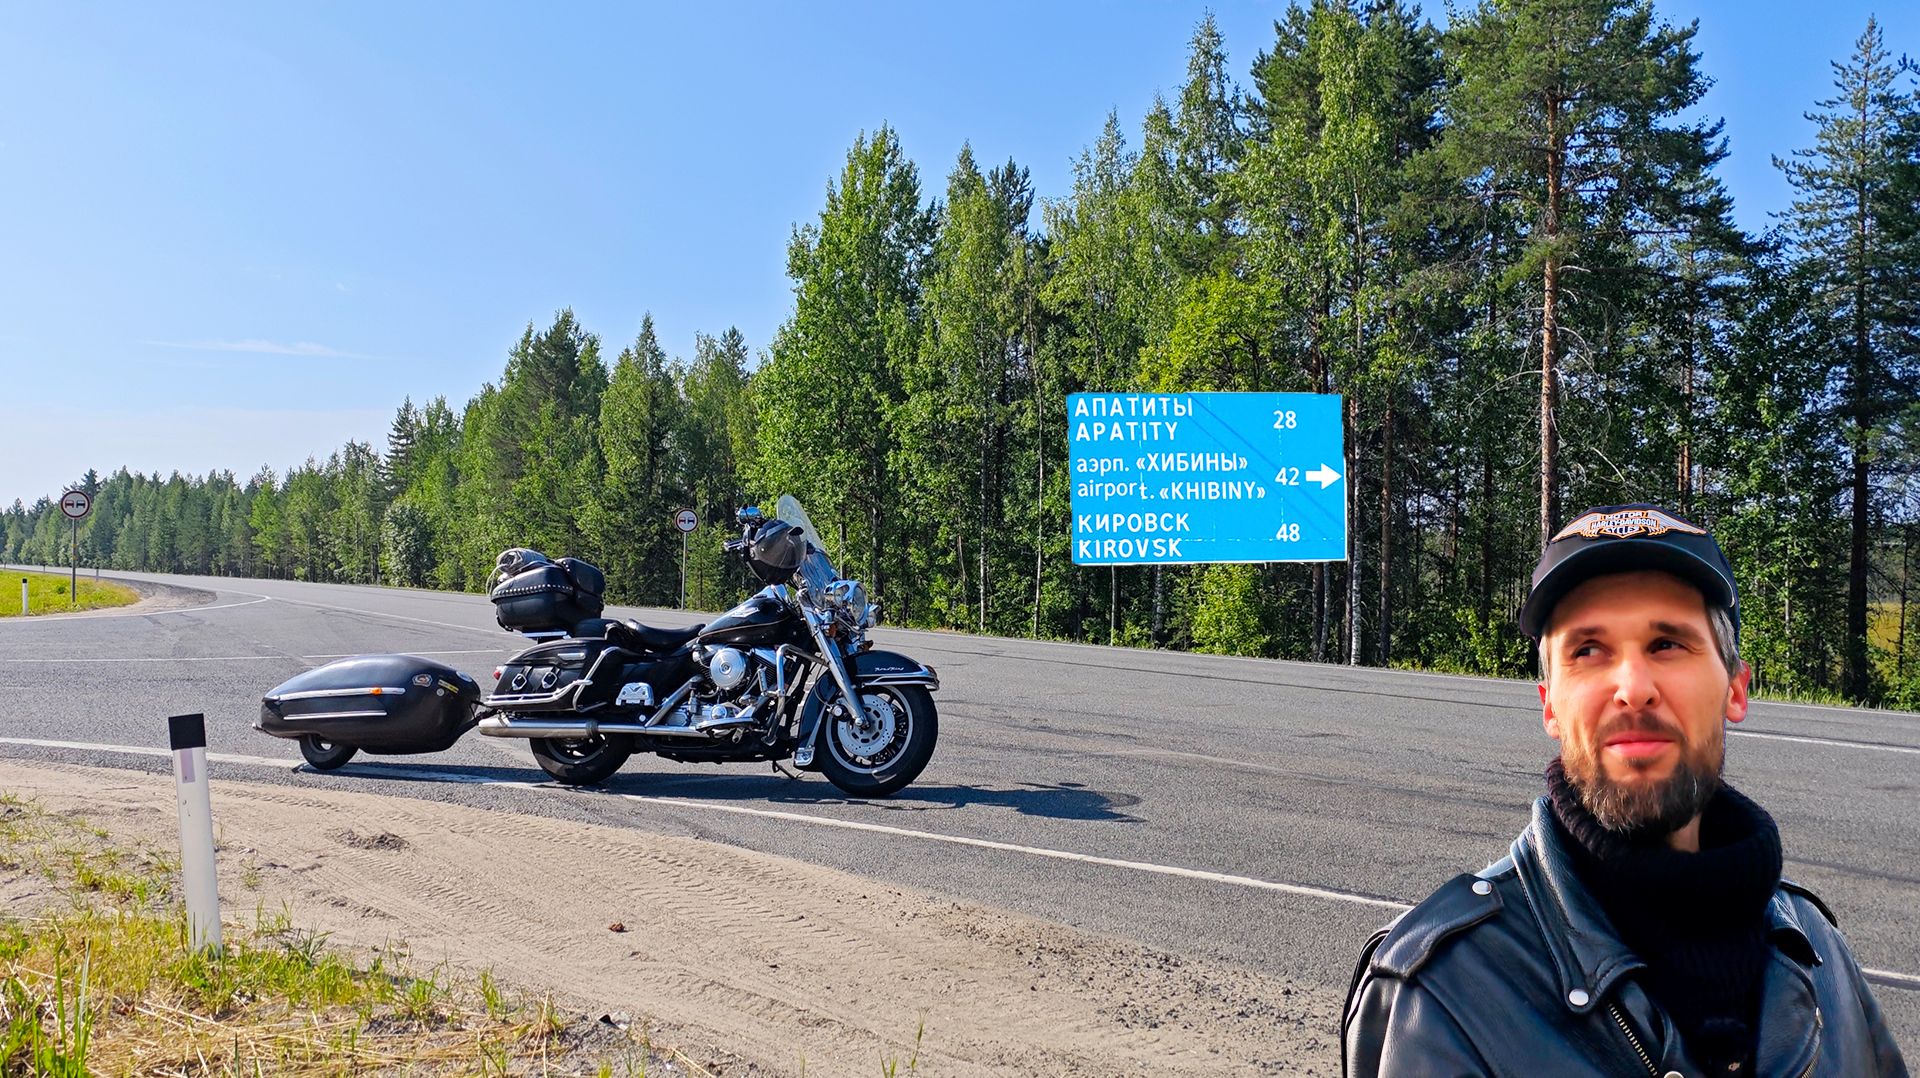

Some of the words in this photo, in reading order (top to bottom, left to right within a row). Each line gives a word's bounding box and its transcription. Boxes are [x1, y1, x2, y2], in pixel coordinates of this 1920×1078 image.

[1074, 397, 1193, 417] АПАТИТЫ
[1272, 410, 1298, 429] 28
[1075, 421, 1178, 442] APATITY
[1076, 458, 1130, 477] аэрп.
[1275, 467, 1300, 486] 42
[1078, 512, 1190, 534] КИРОВСК
[1276, 523, 1301, 543] 48
[1078, 537, 1183, 559] KIROVSK
